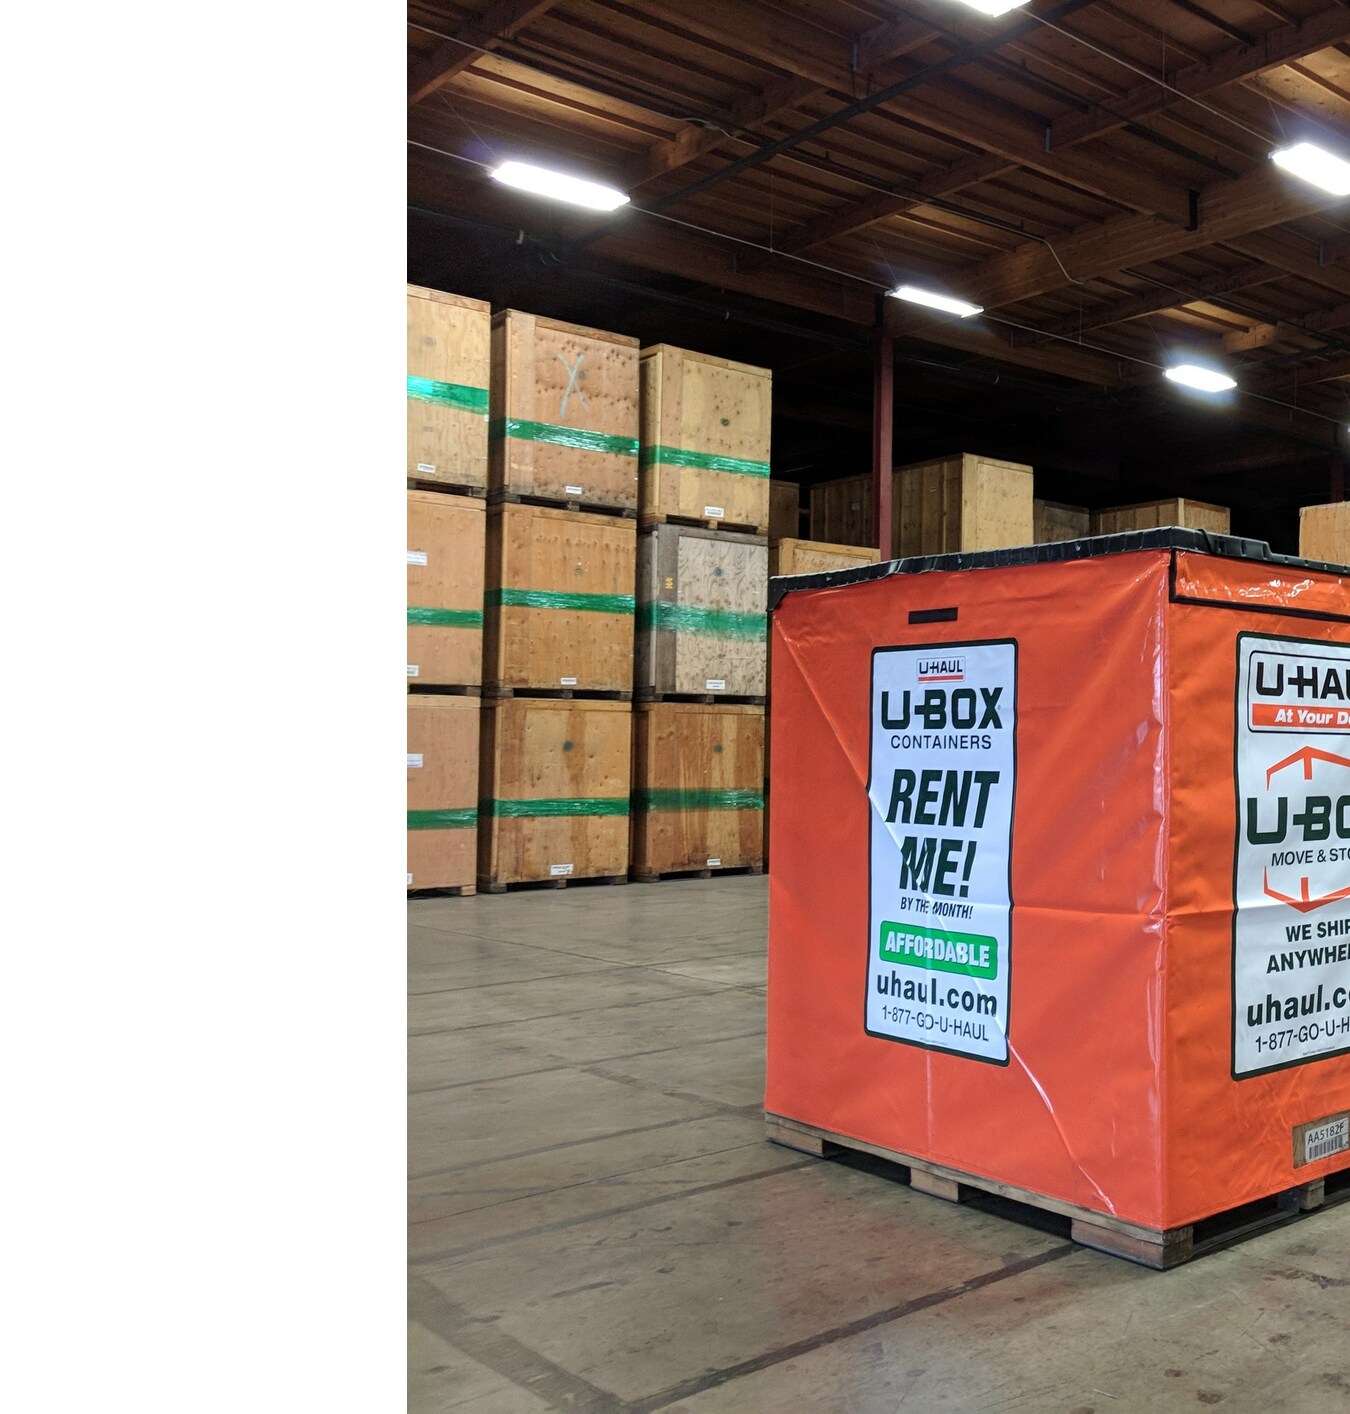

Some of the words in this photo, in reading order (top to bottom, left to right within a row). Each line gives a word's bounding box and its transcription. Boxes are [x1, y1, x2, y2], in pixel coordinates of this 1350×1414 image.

[918, 660, 963, 674] U-HAUL
[881, 687, 1003, 730] U-BOX
[1274, 708, 1293, 723] At
[1297, 710, 1334, 725] Your
[890, 734, 992, 750] CONTAINERS
[885, 769, 1000, 828] RENT
[899, 836, 977, 898] ME!
[1271, 849, 1314, 866] MOVE
[1317, 849, 1327, 863] &
[900, 896, 914, 910] BY
[916, 898, 930, 914] THE
[932, 901, 974, 919] MONTH!
[1286, 924, 1312, 942] WE
[885, 931, 990, 968] AFFORDABLE
[877, 970, 998, 1017] uhaul.com
[882, 1005, 989, 1041] 1-877-GO-U-HAUL
